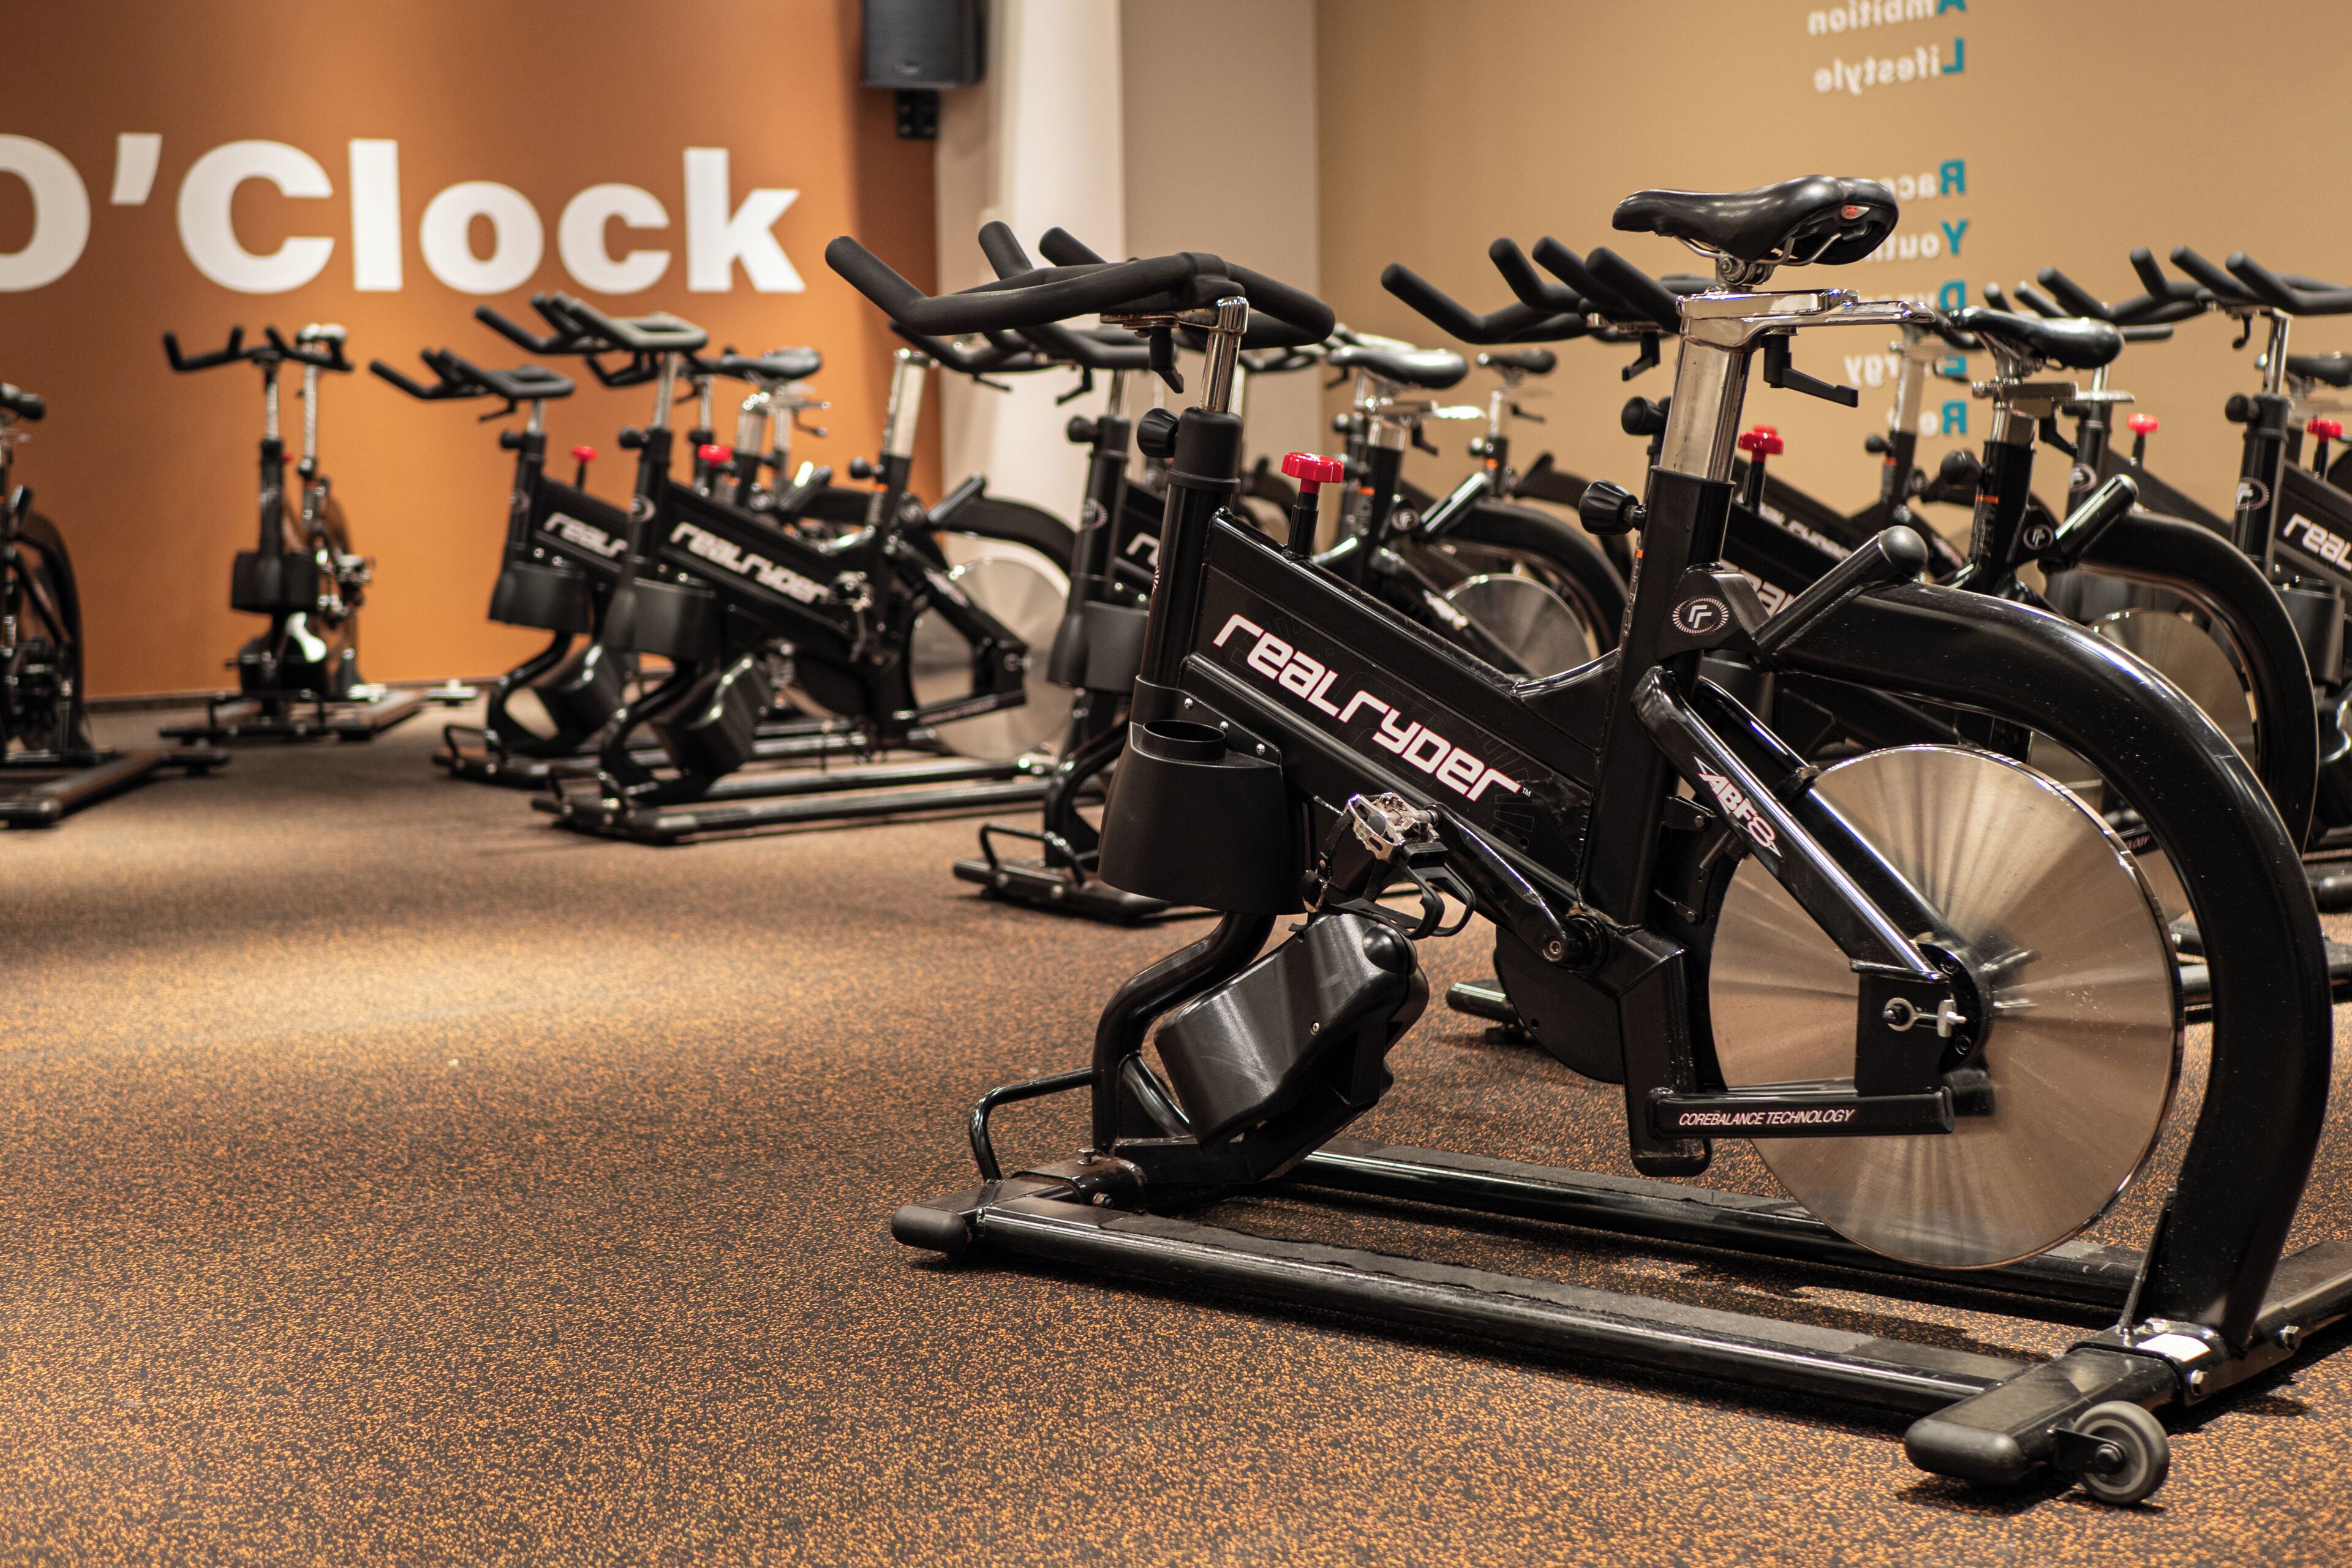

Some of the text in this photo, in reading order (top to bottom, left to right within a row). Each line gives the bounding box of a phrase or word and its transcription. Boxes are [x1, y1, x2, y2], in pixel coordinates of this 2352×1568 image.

[0, 132, 806, 294] O'Clock
[1679, 1109, 1855, 1126] COREBALANCE TECHNOLOGY
